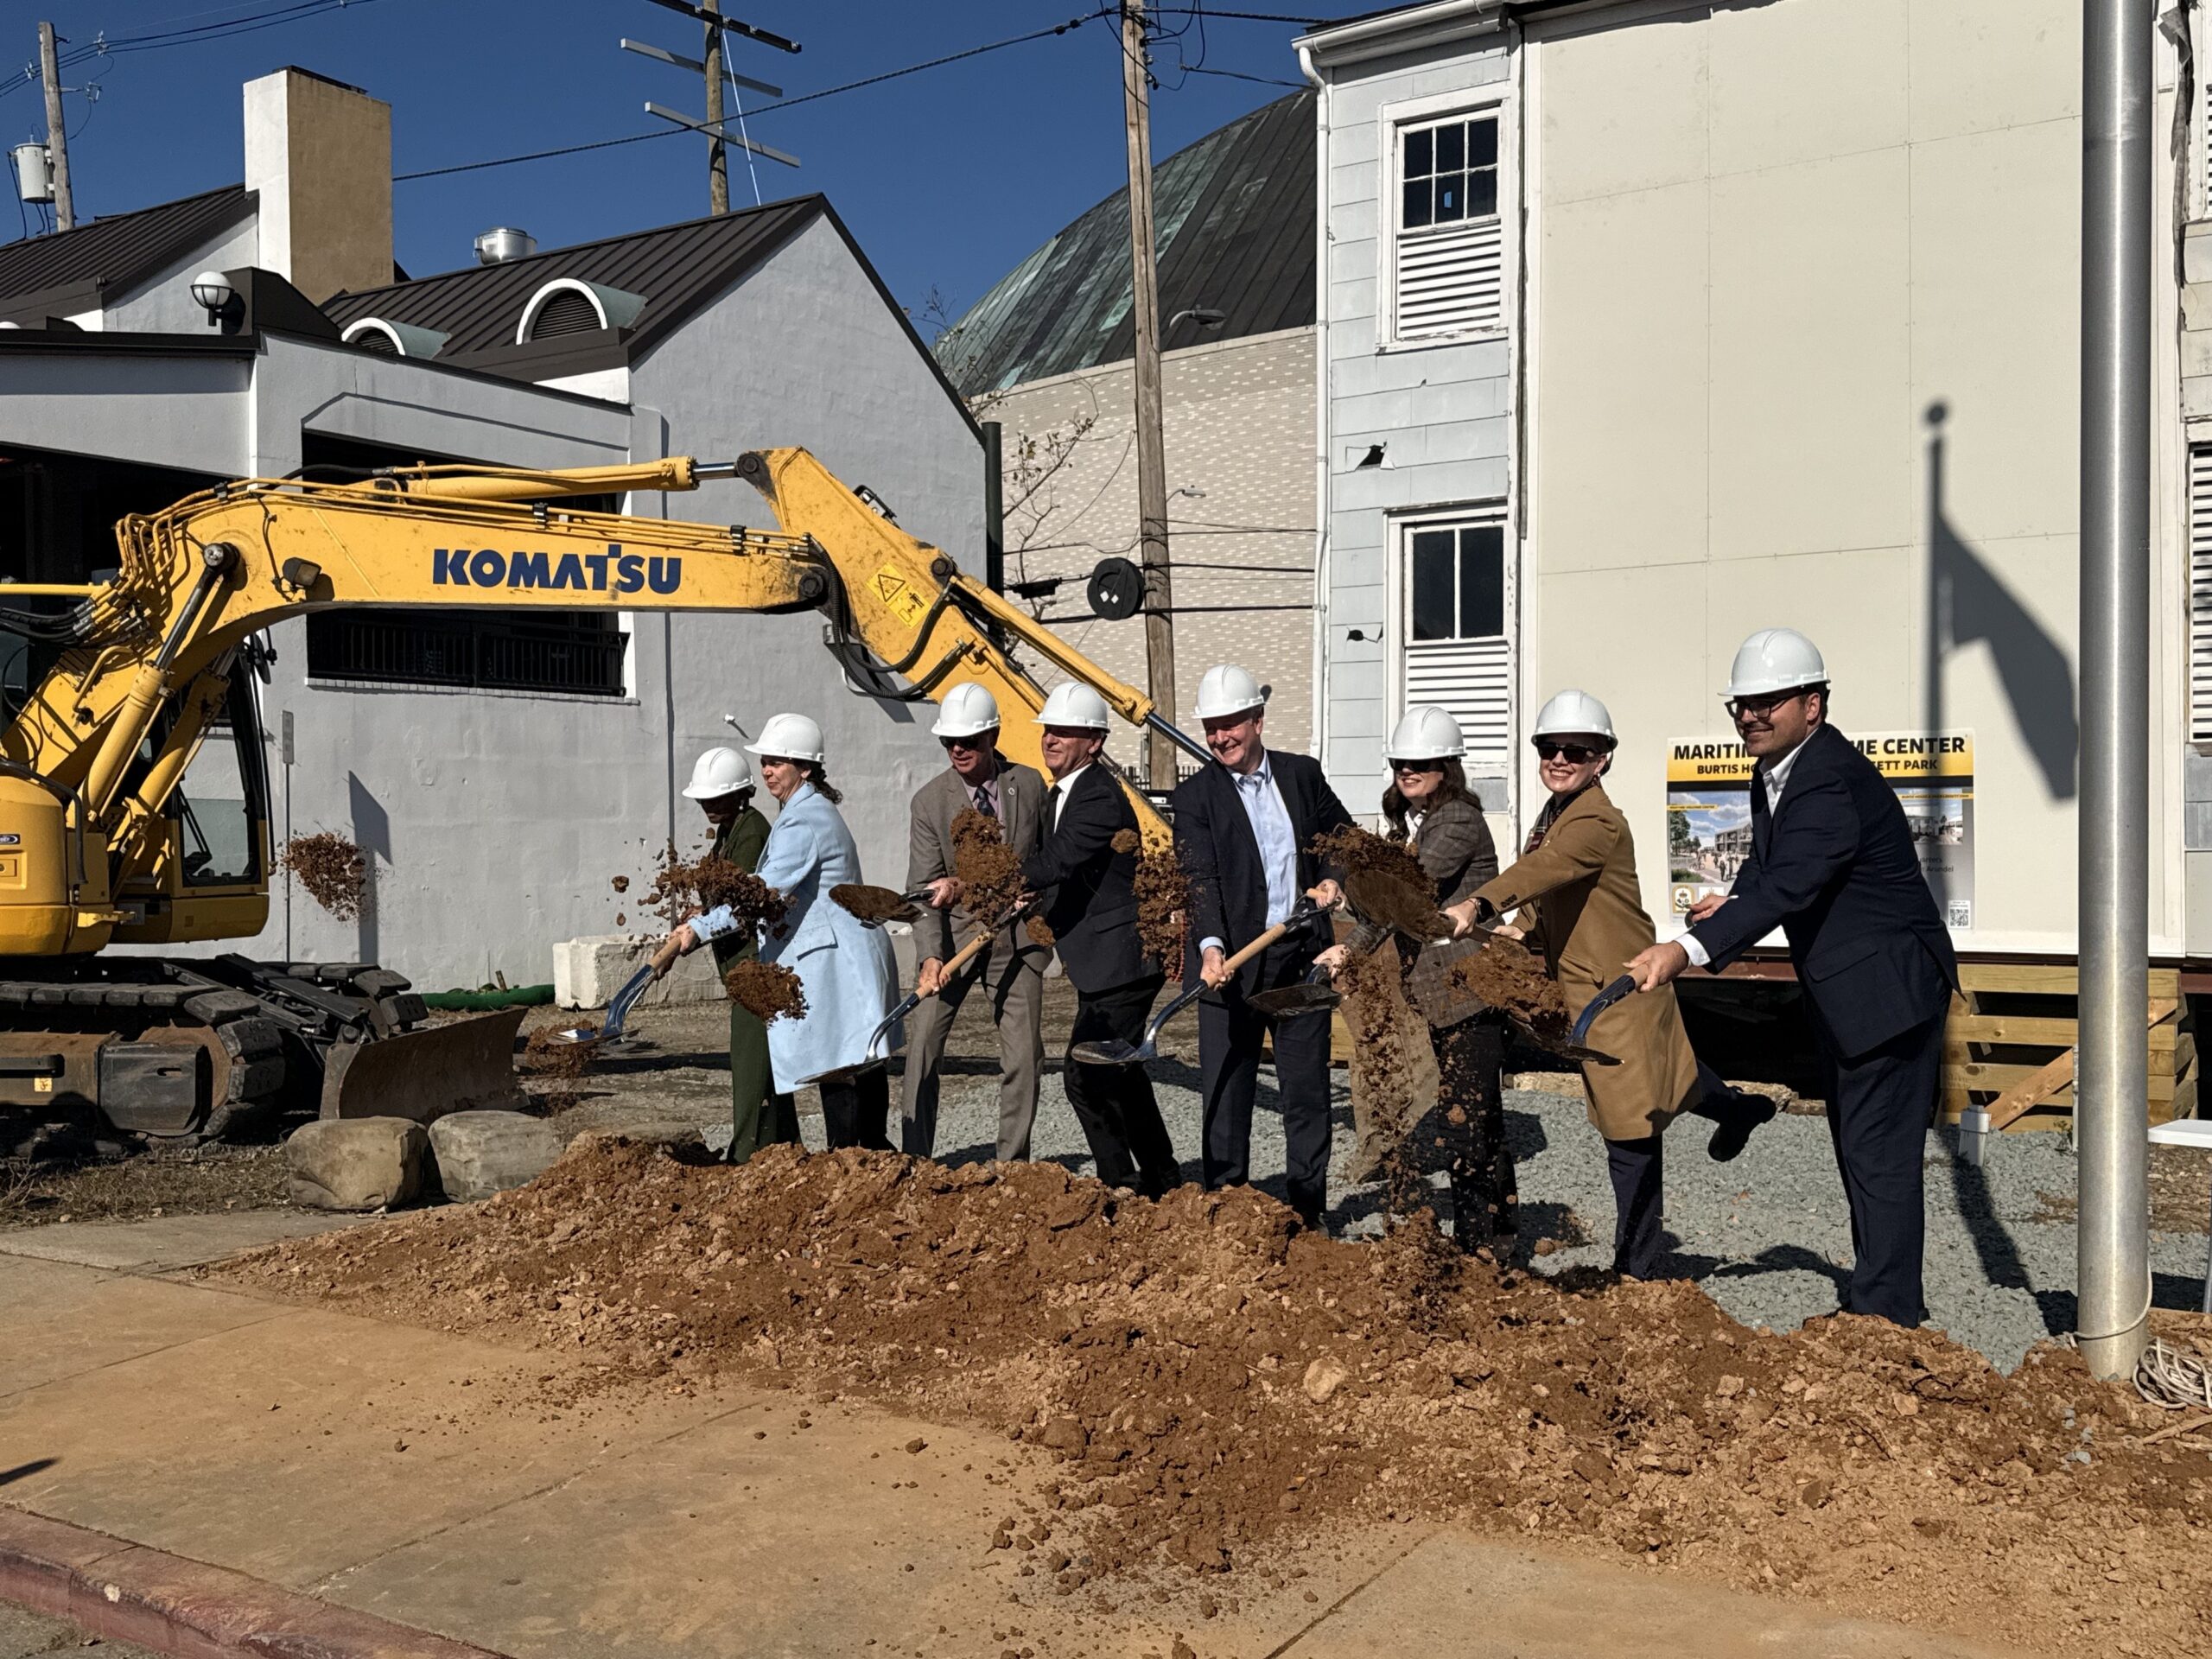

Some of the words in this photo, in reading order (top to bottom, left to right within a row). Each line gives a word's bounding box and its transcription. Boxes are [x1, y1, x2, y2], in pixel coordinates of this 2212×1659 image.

[433, 544, 682, 594] KOMATSU
[1883, 737, 1966, 754] CENTER
[1697, 764, 1738, 774] BURTIS
[1904, 760, 1938, 771] PARK
